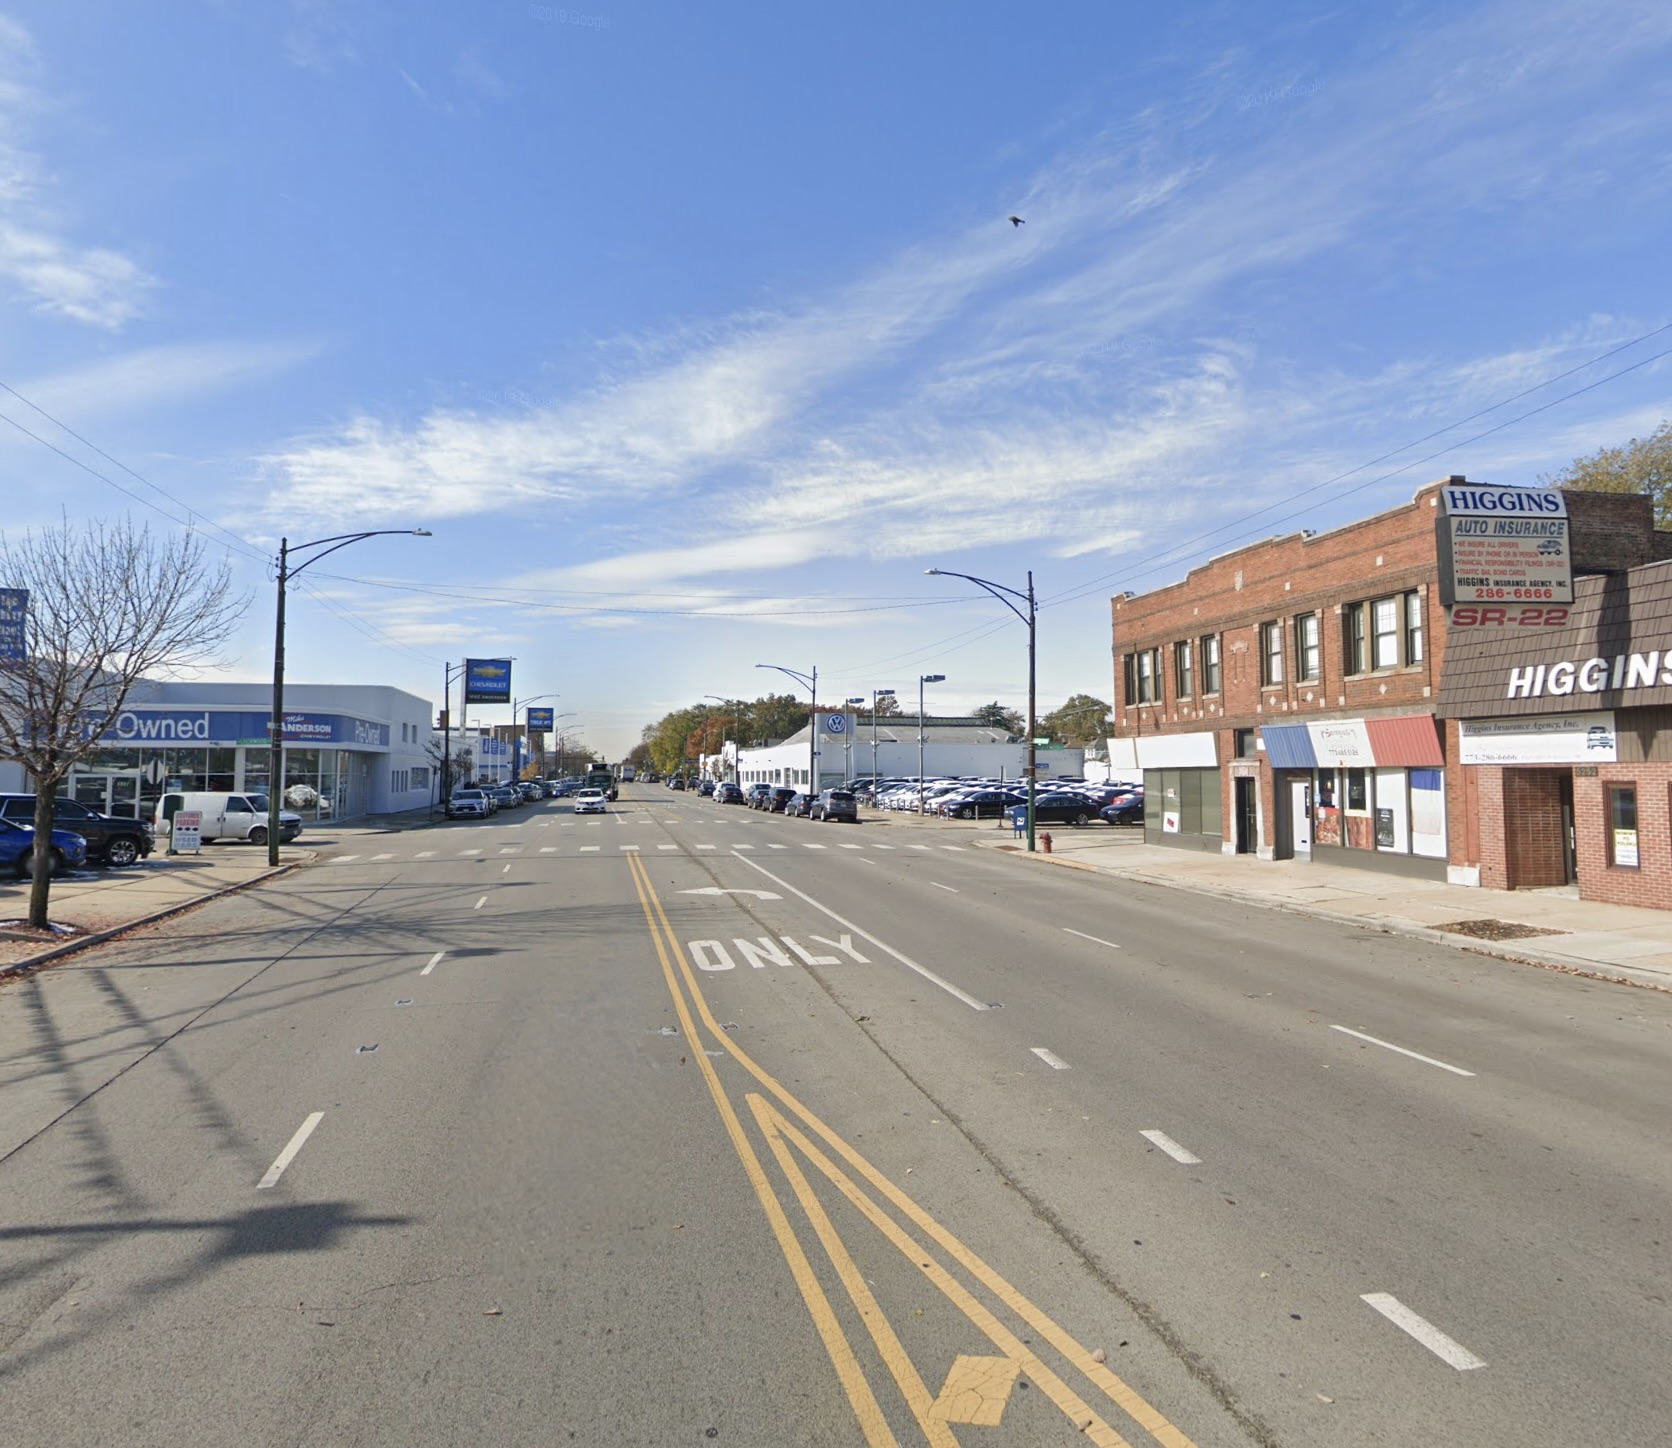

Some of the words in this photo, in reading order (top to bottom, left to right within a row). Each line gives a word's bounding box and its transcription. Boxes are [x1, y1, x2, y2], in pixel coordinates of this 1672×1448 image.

[1448, 491, 1560, 512] HIGGINS
[1456, 520, 1488, 534] AUTO
[1493, 521, 1565, 536] INSURANCE
[1457, 577, 1490, 587] HIGGINS
[1476, 588, 1552, 598] 286-6666
[1452, 608, 1568, 626] SR-22
[281, 722, 331, 733] ANDERSON
[1465, 724, 1492, 733] Higgins
[1493, 723, 1530, 731] Insurance
[1563, 719, 1580, 728] Inc.
[688, 934, 872, 971] ONLY
